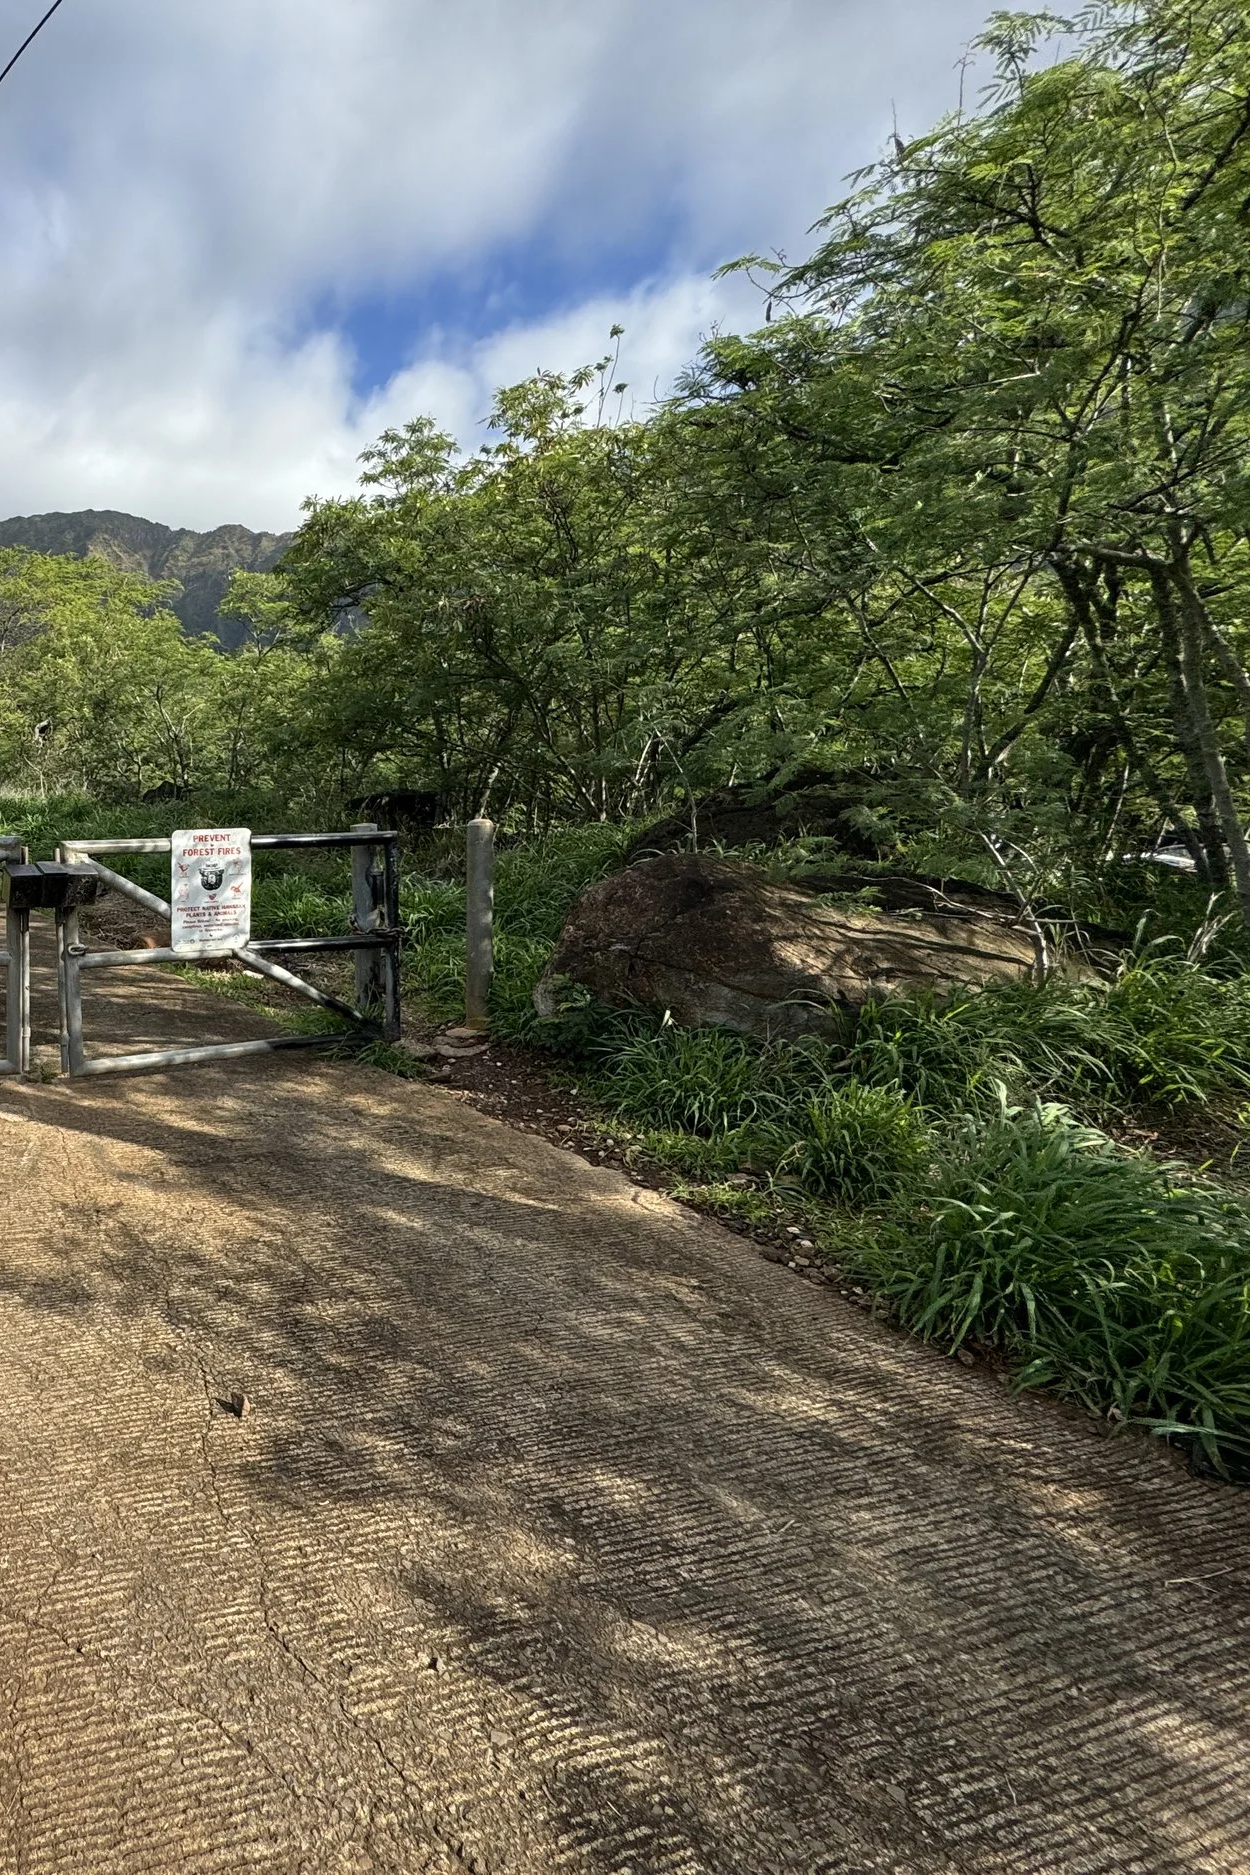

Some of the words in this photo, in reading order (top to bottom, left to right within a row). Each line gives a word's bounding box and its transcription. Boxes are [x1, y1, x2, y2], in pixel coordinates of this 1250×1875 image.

[193, 833, 231, 842] PREVENT
[182, 848, 215, 856] FOREST
[217, 847, 241, 855] FIRES
